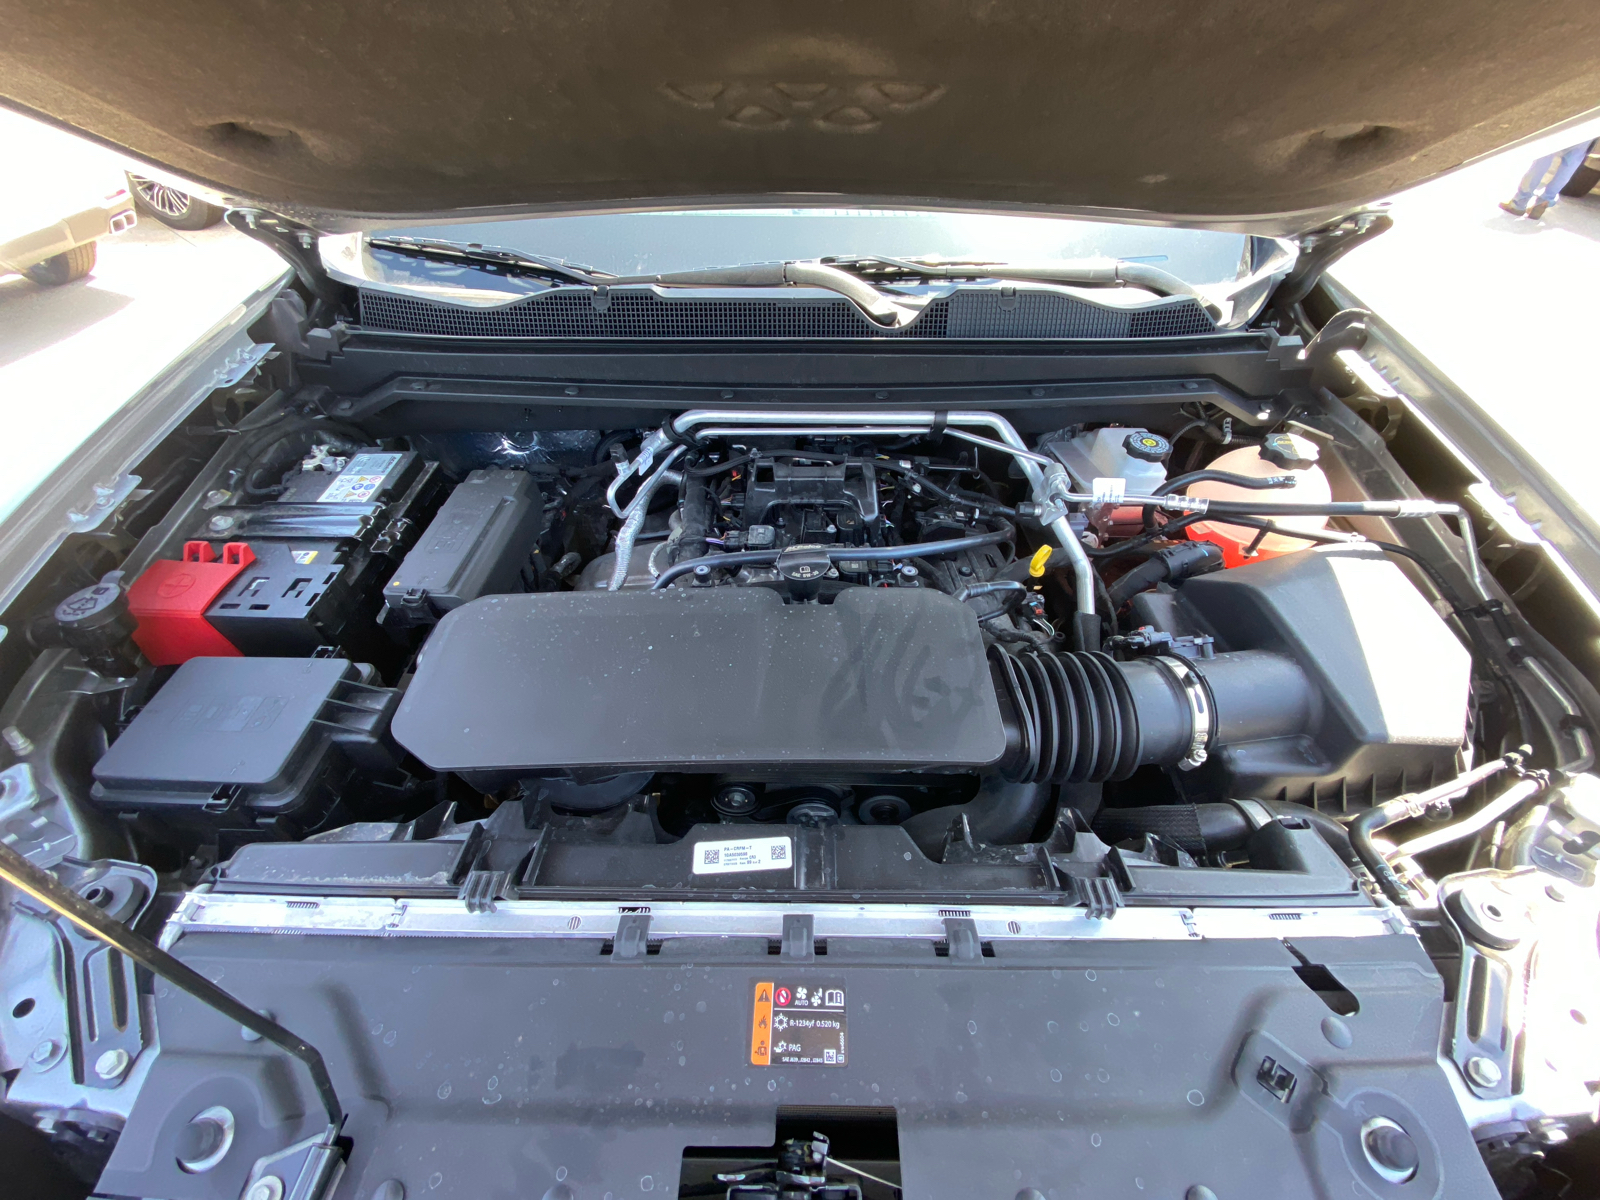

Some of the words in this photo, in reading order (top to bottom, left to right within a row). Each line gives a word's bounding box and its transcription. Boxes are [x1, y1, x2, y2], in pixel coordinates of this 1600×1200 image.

[789, 1019, 815, 1029] R-1234yf
[832, 1021, 840, 1030] kg
[788, 1043, 802, 1052] PAG
